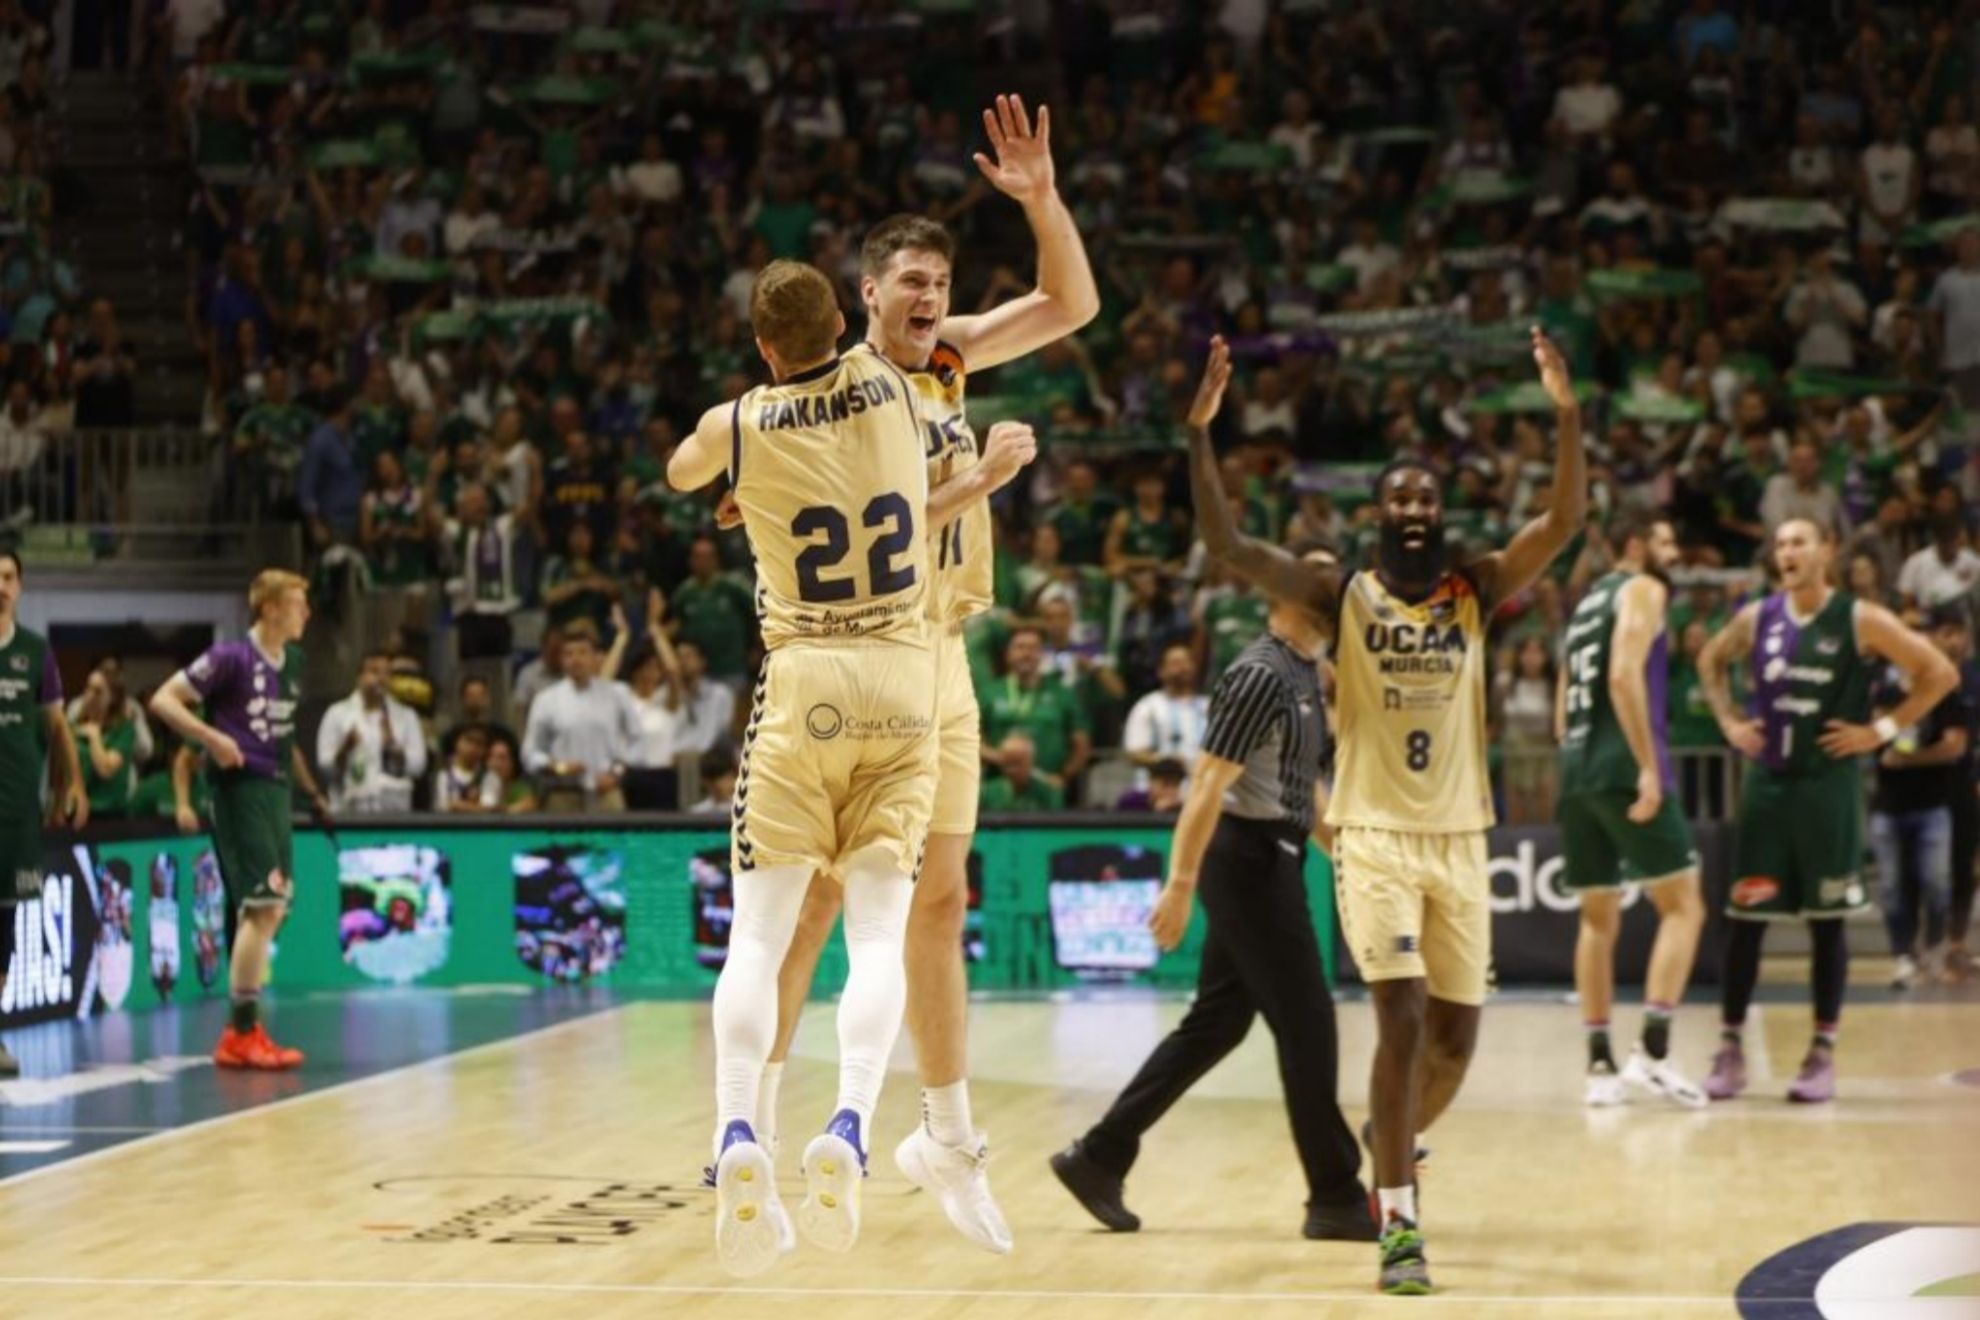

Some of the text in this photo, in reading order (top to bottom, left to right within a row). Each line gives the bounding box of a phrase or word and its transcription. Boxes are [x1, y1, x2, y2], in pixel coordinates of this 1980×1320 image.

[759, 373, 896, 432] HAKANSON
[791, 491, 917, 603] 22
[1379, 656, 1454, 674] MURCIA
[845, 716, 882, 731] Costa
[1406, 729, 1431, 772] 8
